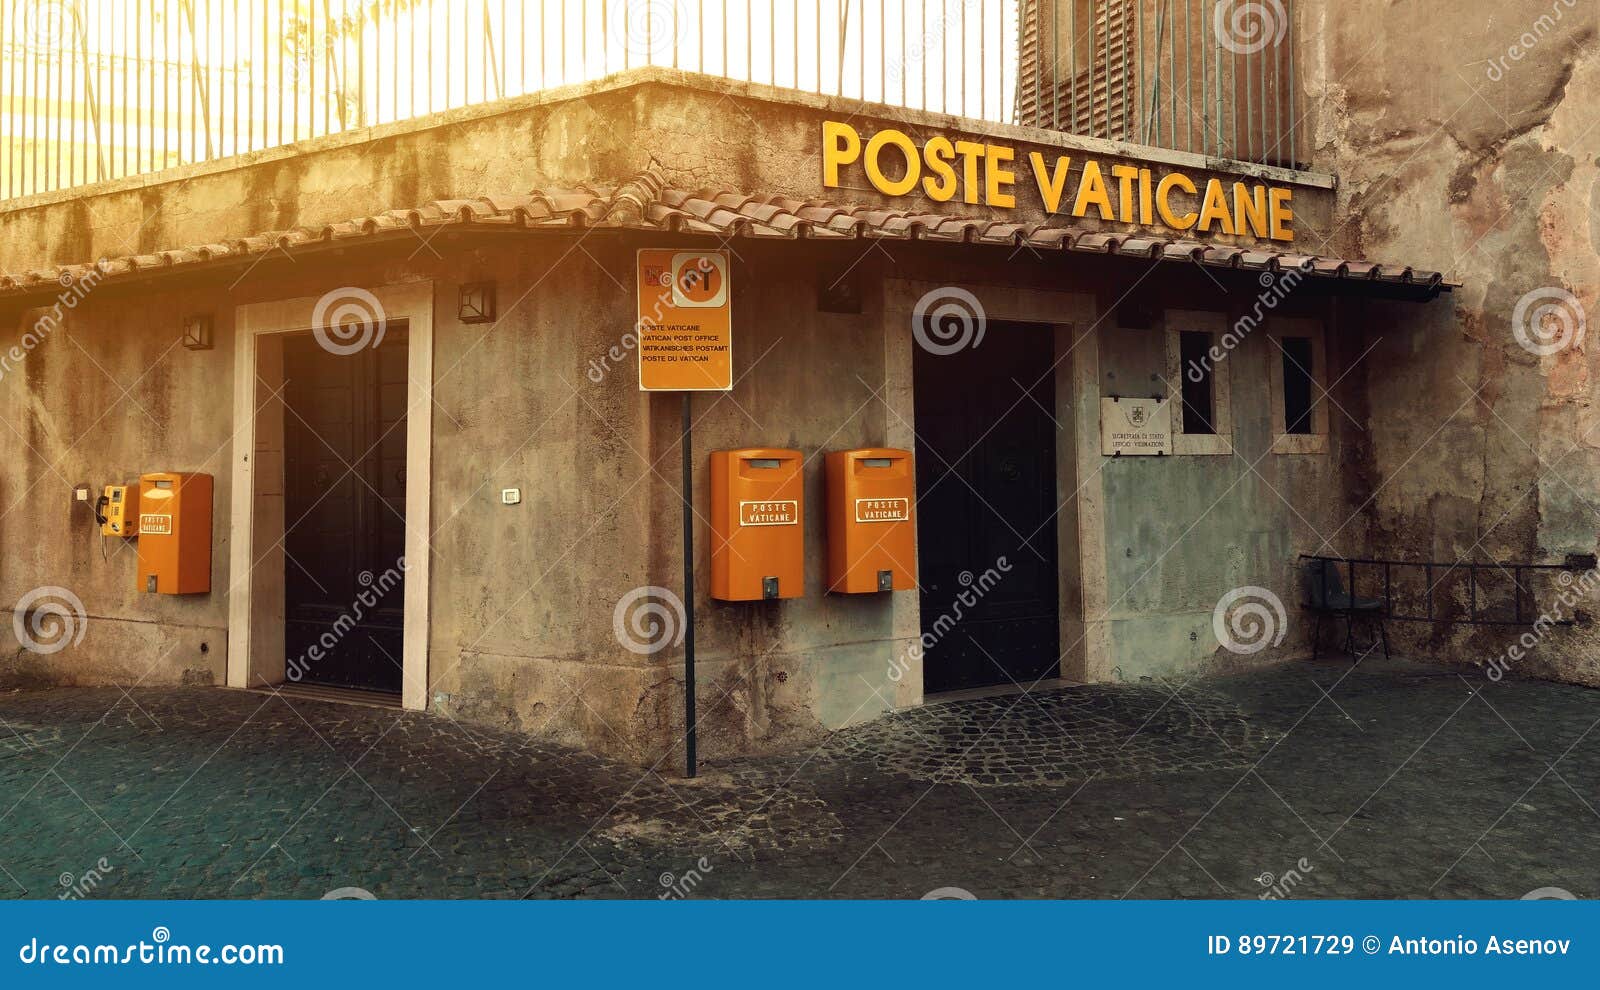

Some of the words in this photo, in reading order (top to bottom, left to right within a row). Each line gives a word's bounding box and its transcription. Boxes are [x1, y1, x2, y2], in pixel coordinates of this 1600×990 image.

[822, 120, 1016, 209] POSTE
[1029, 150, 1295, 242] VATICANE
[753, 503, 788, 512] POSTE
[867, 501, 899, 509] POSTE
[749, 513, 790, 522] VATICANE
[864, 510, 902, 519] VATICANE
